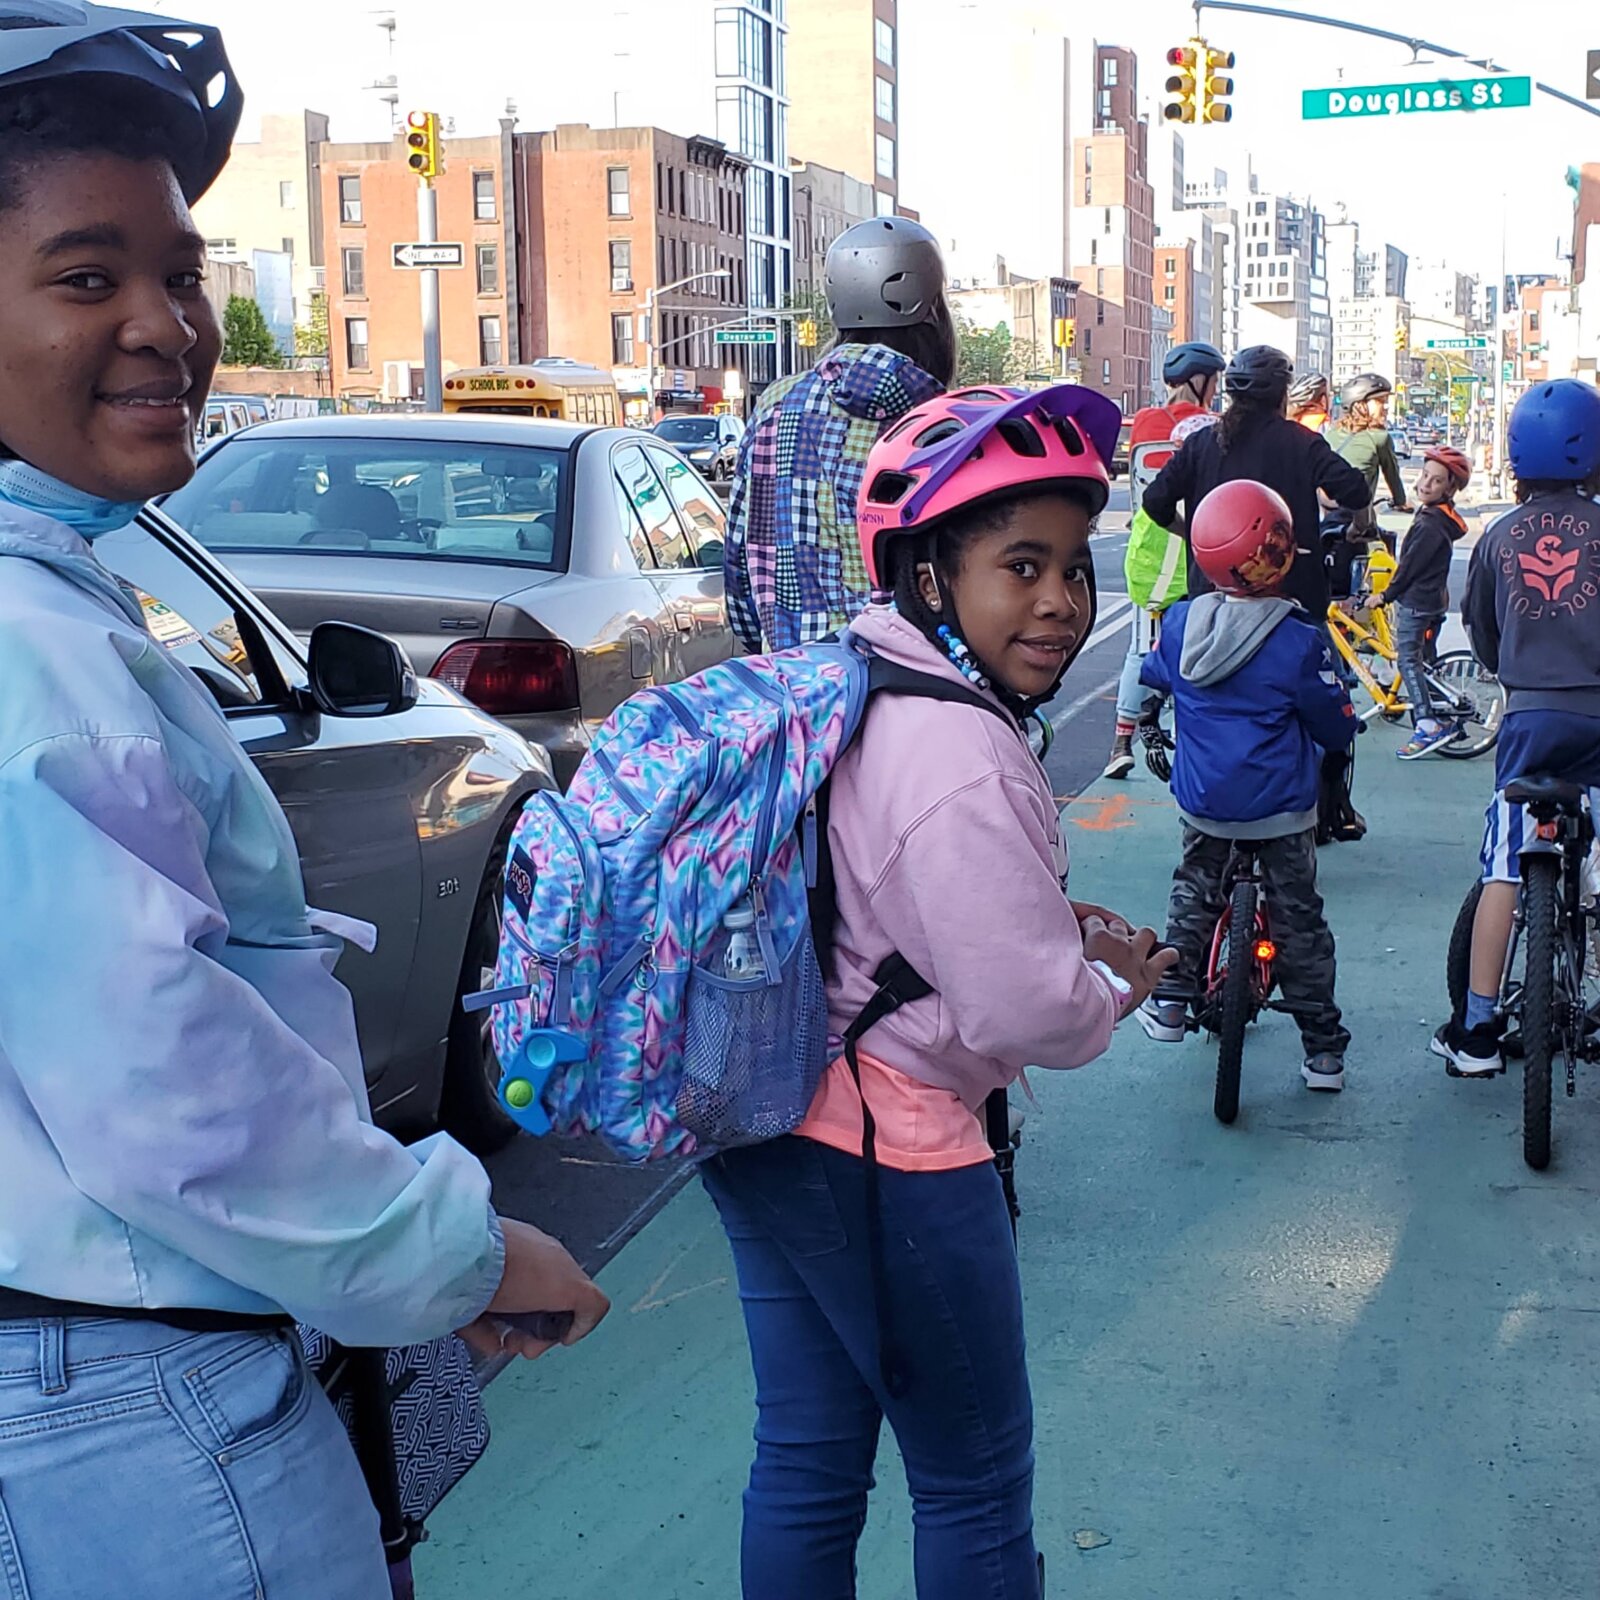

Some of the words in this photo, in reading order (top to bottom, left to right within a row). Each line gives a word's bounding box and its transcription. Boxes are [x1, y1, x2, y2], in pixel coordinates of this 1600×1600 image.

[1328, 87, 1462, 115] Douglass
[1471, 82, 1503, 106] St
[470, 378, 495, 392] SCHOOL
[496, 378, 510, 391] BUS
[1510, 512, 1590, 540] STARS
